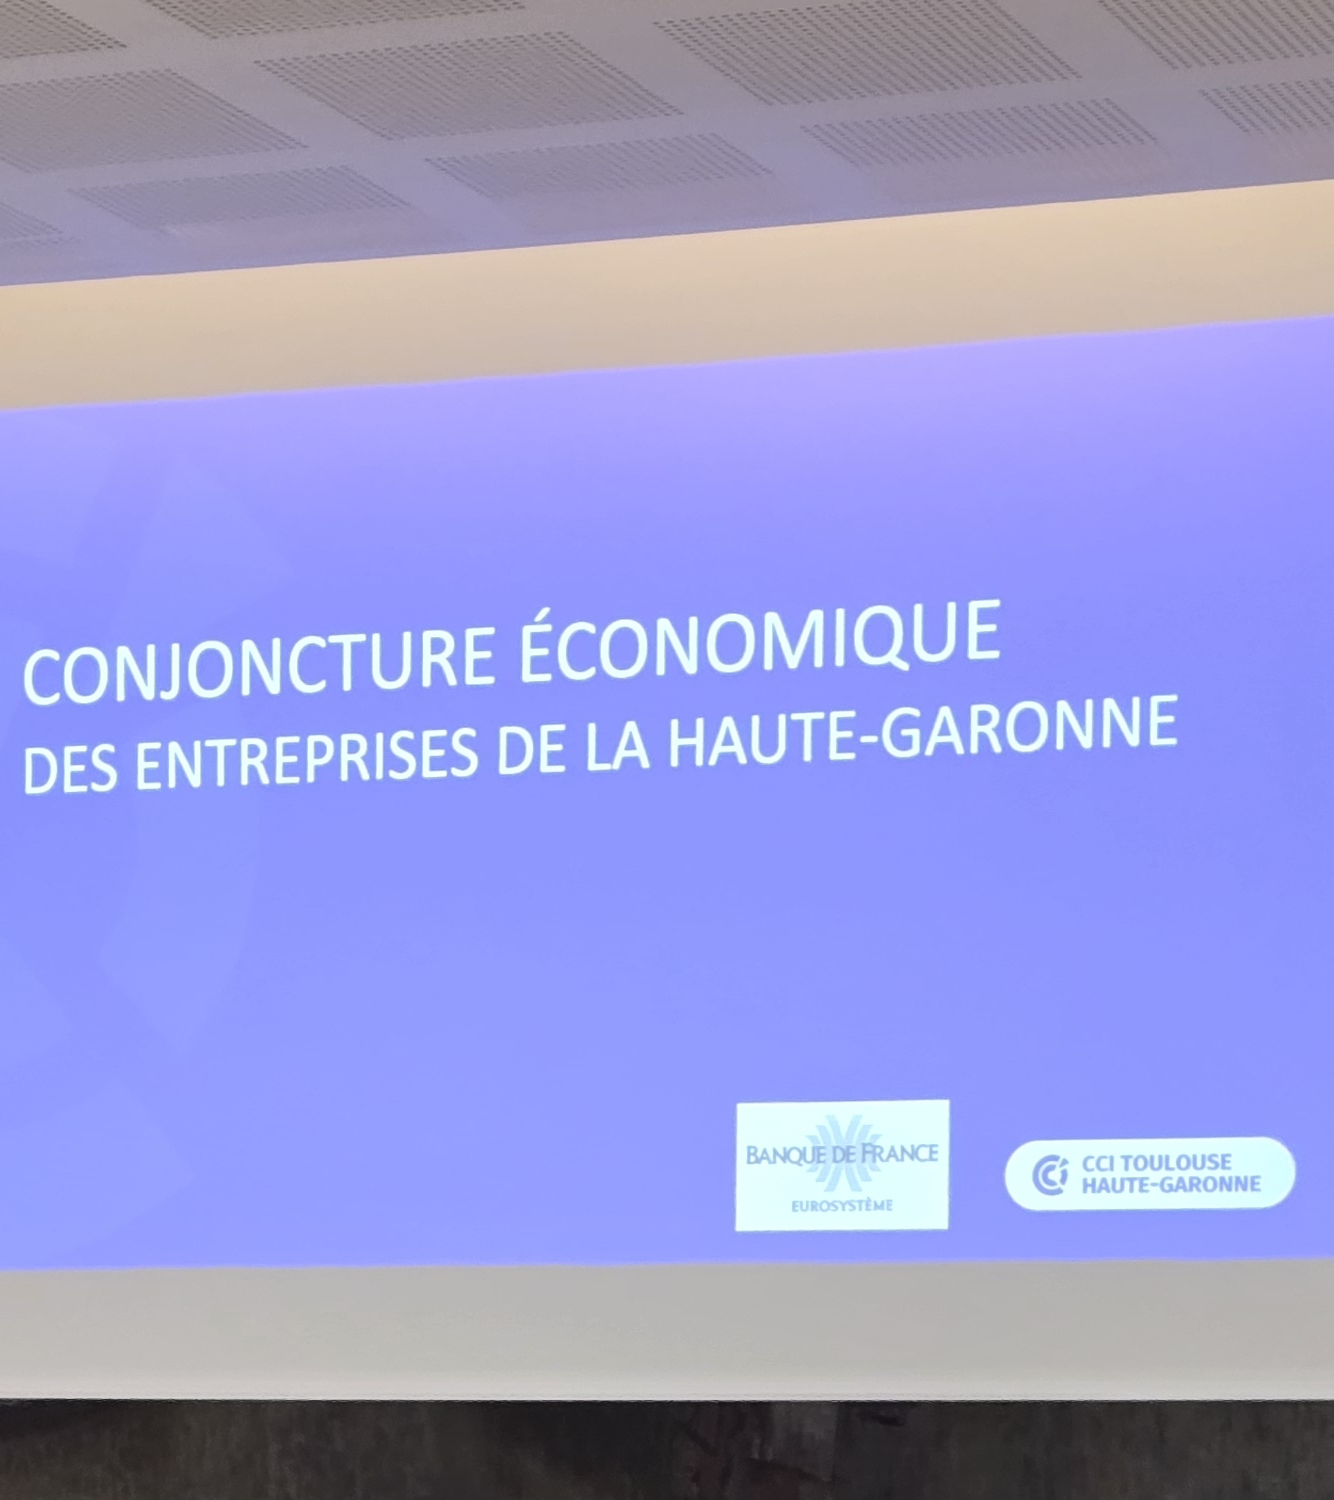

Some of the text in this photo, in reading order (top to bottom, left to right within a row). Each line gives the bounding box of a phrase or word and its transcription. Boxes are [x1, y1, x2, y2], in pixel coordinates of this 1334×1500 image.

[22, 599, 1001, 706] CONJONCTURE ÉCONOMIQUE
[23, 694, 1179, 795] DES ENTREPRISES DE LA HAUTE-GARONNE
[746, 1142, 939, 1167] BANQUE DE FRANCE
[1081, 1153, 1233, 1173] CCI TOULOUSE
[1081, 1175, 1262, 1195] HAUTE-GARONNE
[791, 1196, 894, 1213] EUROSYSTÈME
